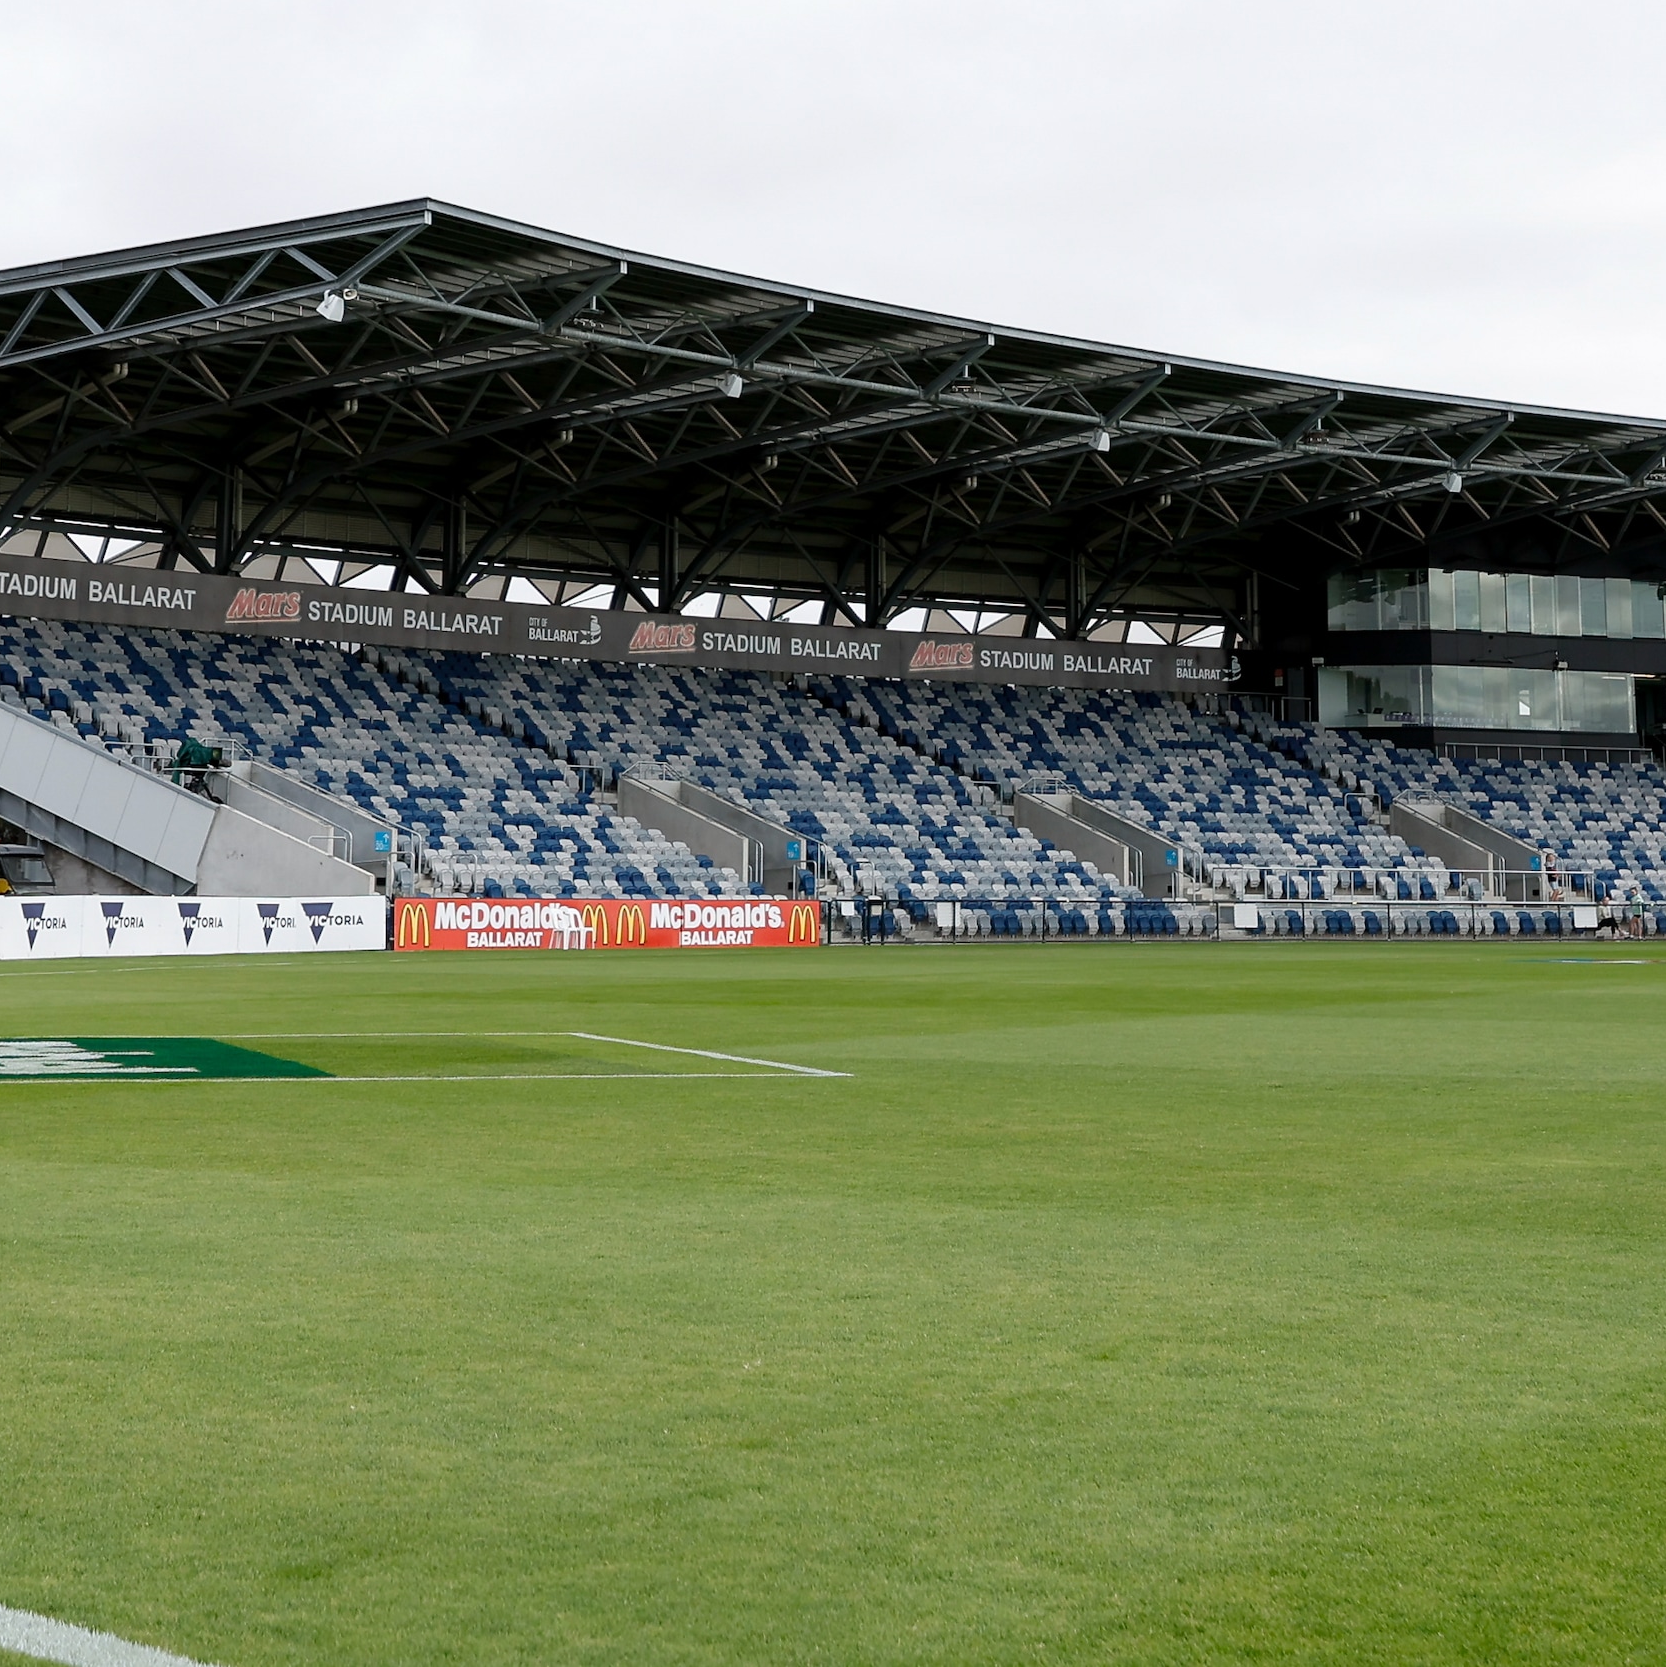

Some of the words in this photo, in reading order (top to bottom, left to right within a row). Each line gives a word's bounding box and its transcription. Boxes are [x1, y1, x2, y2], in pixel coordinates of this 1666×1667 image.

[89, 581, 196, 610] BALLARAT
[227, 588, 300, 619] Mars
[308, 601, 393, 626] STADIUM
[403, 609, 503, 635] BALLARAT
[529, 617, 540, 626] CITY
[541, 618, 548, 626] OF
[528, 628, 579, 643] BALLARAT
[630, 621, 695, 650] Mars
[702, 632, 781, 654] STADIUM
[791, 638, 881, 661] BALLARAT
[910, 641, 973, 668] Mars
[980, 650, 1054, 671] STADIUM
[1063, 654, 1153, 676] BALLARAT
[1176, 658, 1186, 667] CITY
[1176, 668, 1221, 681] BALLARAT
[103, 915, 144, 929] VICTORIA
[181, 915, 223, 929] VICTORIA
[261, 916, 296, 929] VICTORI
[307, 914, 364, 927] VICTORIA
[650, 903, 782, 929] McDonald's
[25, 917, 67, 932] VICTORIA
[467, 932, 543, 948] BALLARAT
[680, 930, 754, 946] BALLARAT
